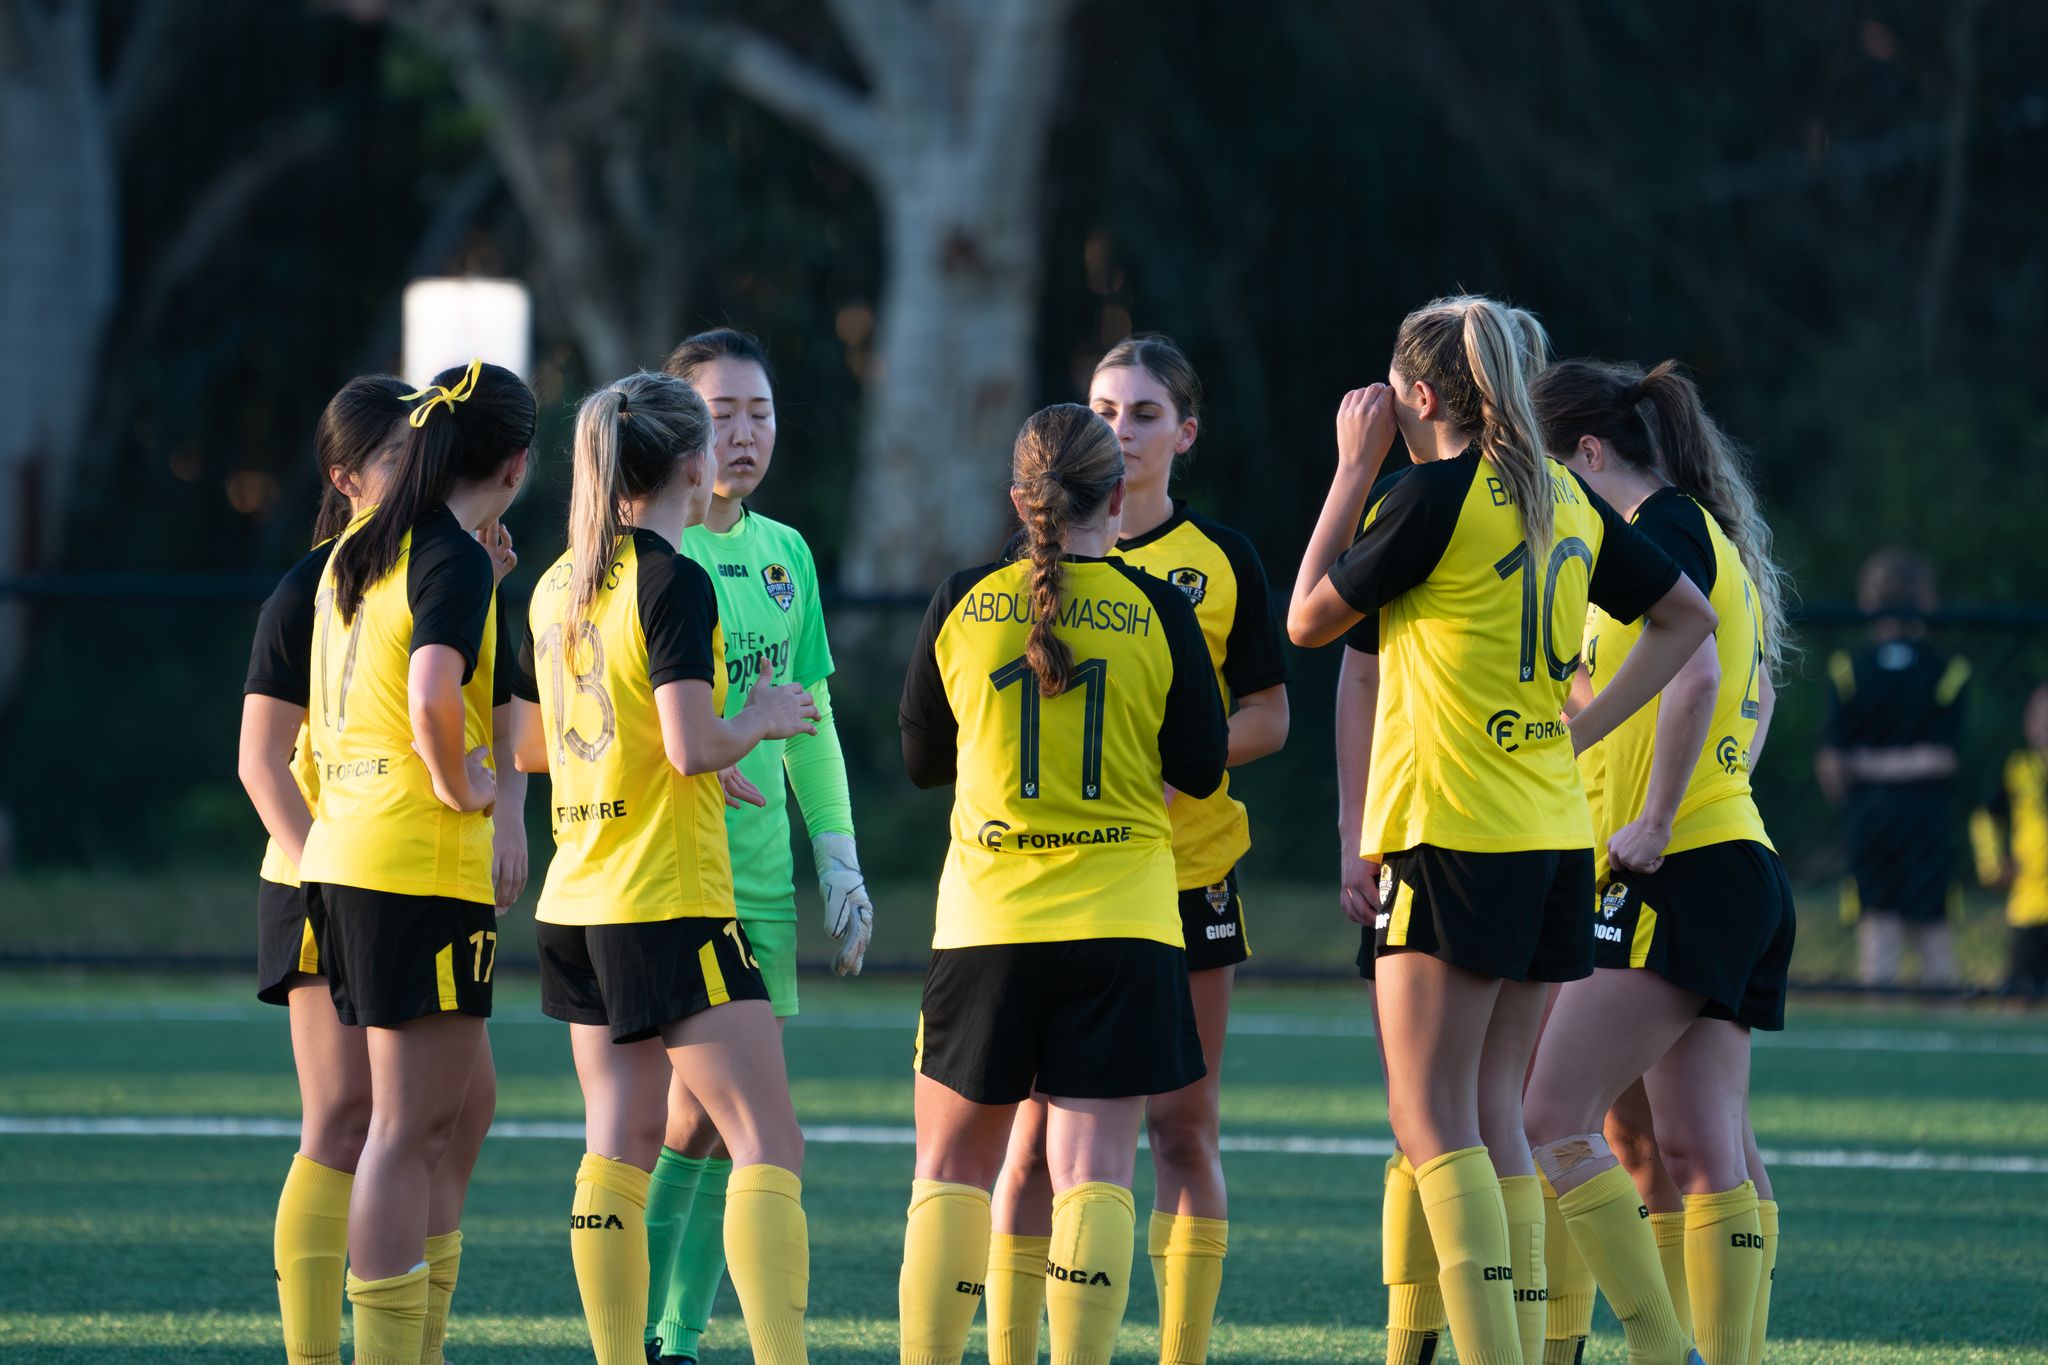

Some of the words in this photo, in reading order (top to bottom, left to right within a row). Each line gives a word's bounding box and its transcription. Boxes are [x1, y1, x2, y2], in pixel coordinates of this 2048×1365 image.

[717, 563, 749, 578] GIOCA
[1493, 536, 1594, 683] 10
[731, 632, 756, 650] THE
[534, 618, 616, 765] 13
[988, 654, 1108, 801] 11
[327, 758, 389, 781] FORCARE
[1017, 826, 1133, 849] FORKCARE
[1593, 922, 1623, 943] IOCA
[468, 930, 497, 983] 17
[722, 920, 760, 970] 1
[570, 1214, 625, 1230] IOCA
